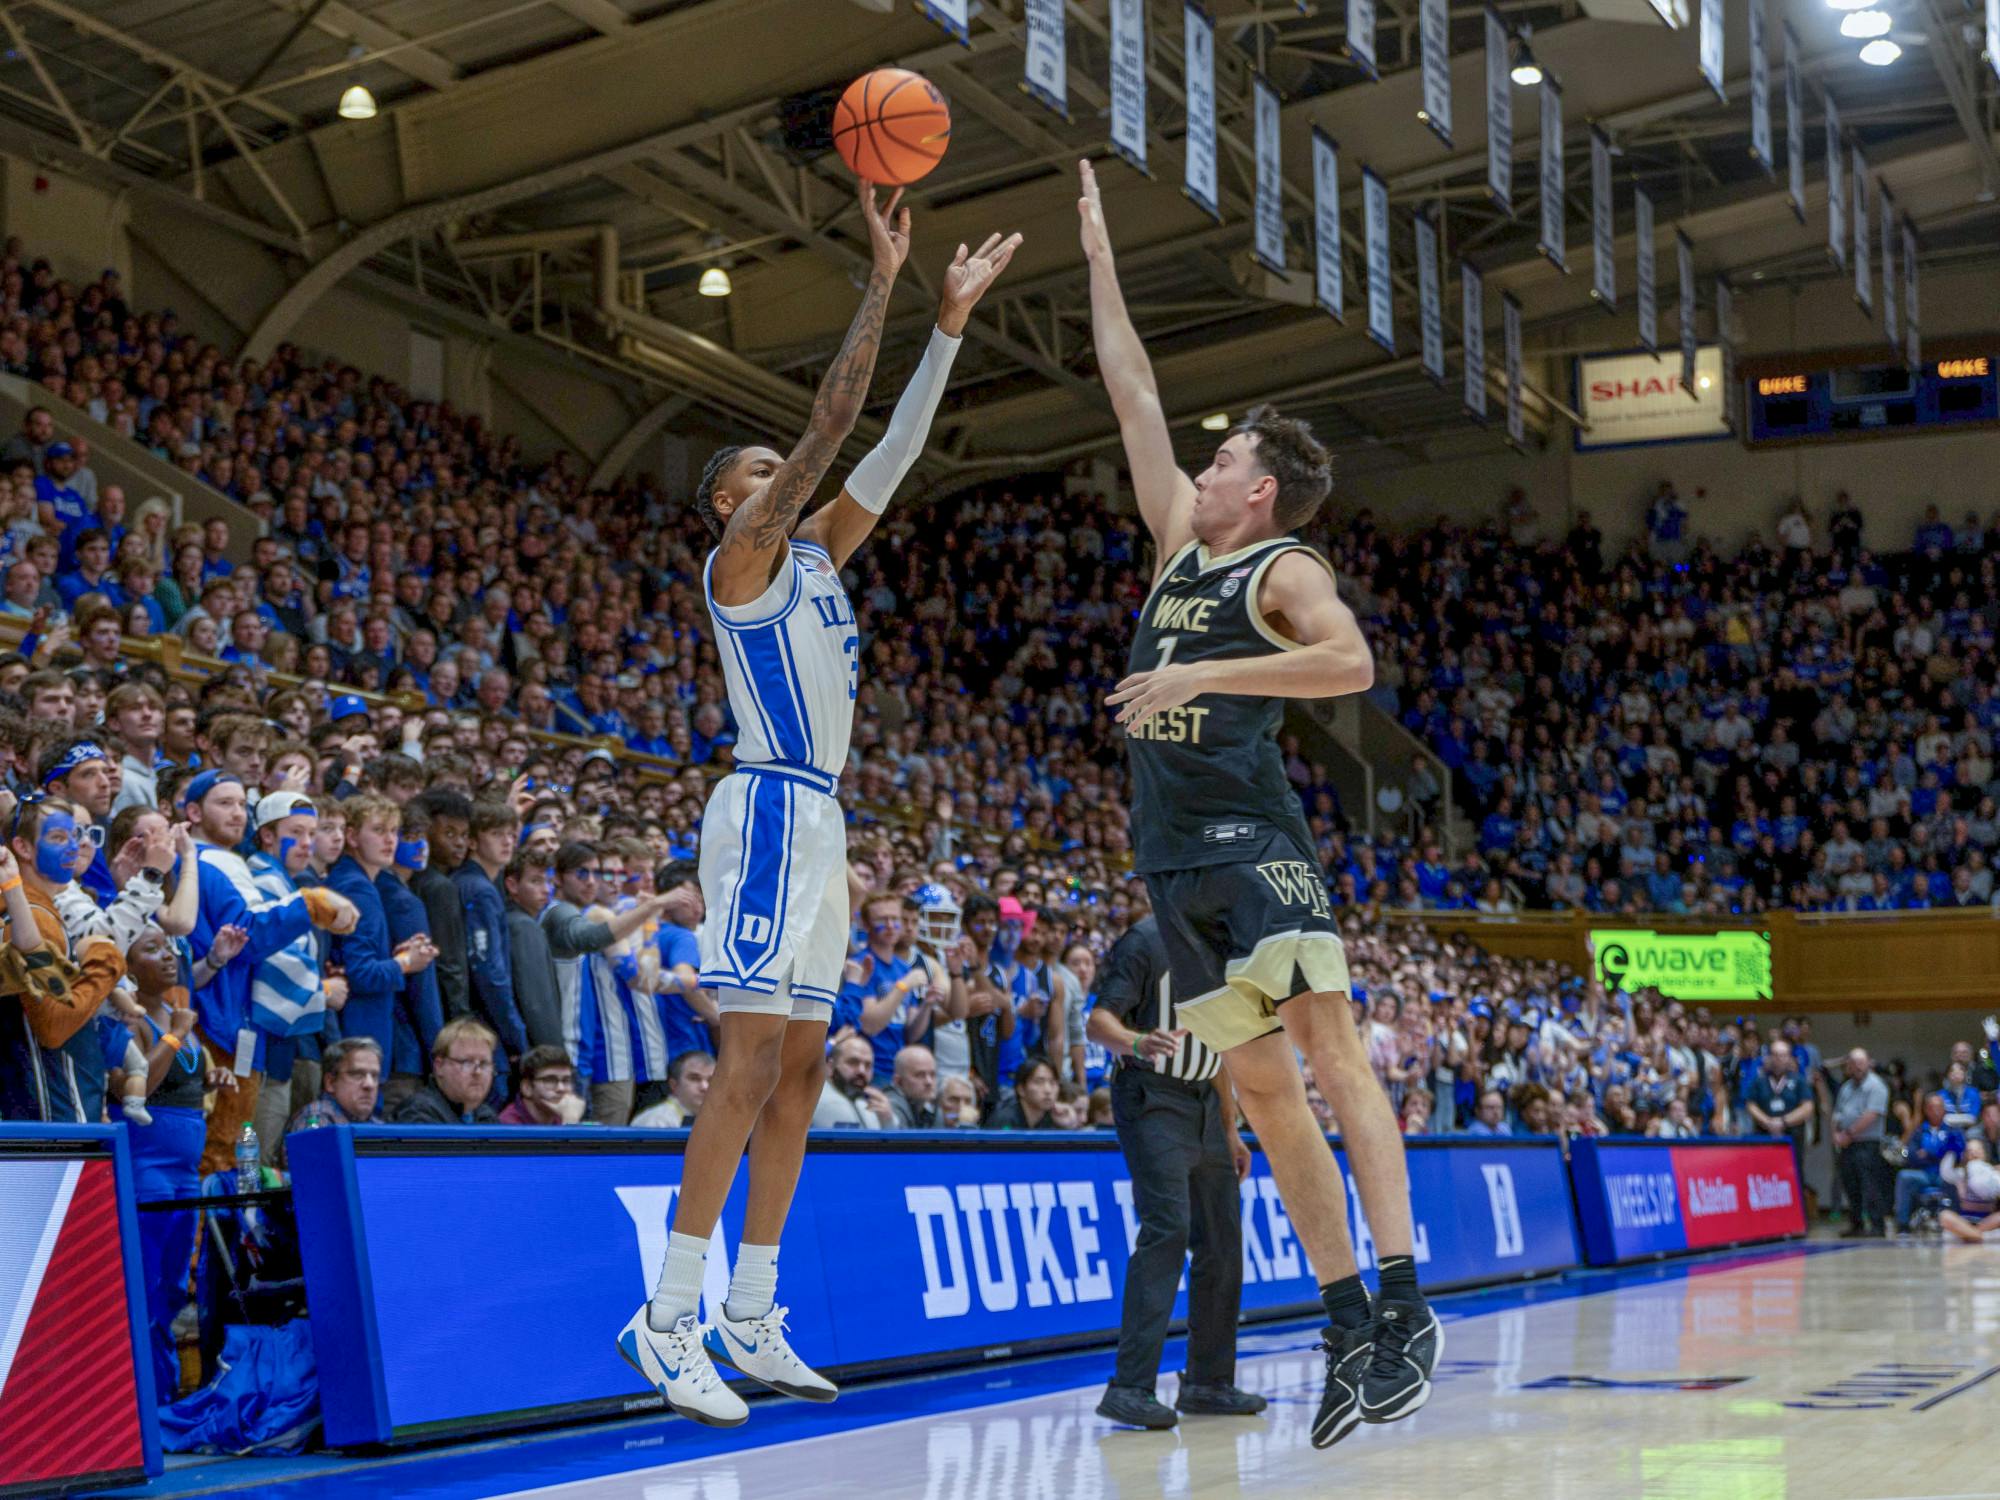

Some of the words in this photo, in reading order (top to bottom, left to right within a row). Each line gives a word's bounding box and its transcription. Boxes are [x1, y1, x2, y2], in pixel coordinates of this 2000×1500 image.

[1152, 595, 1219, 632] WAKE
[738, 914, 771, 944] D
[904, 1181, 1113, 1320] DUKE
